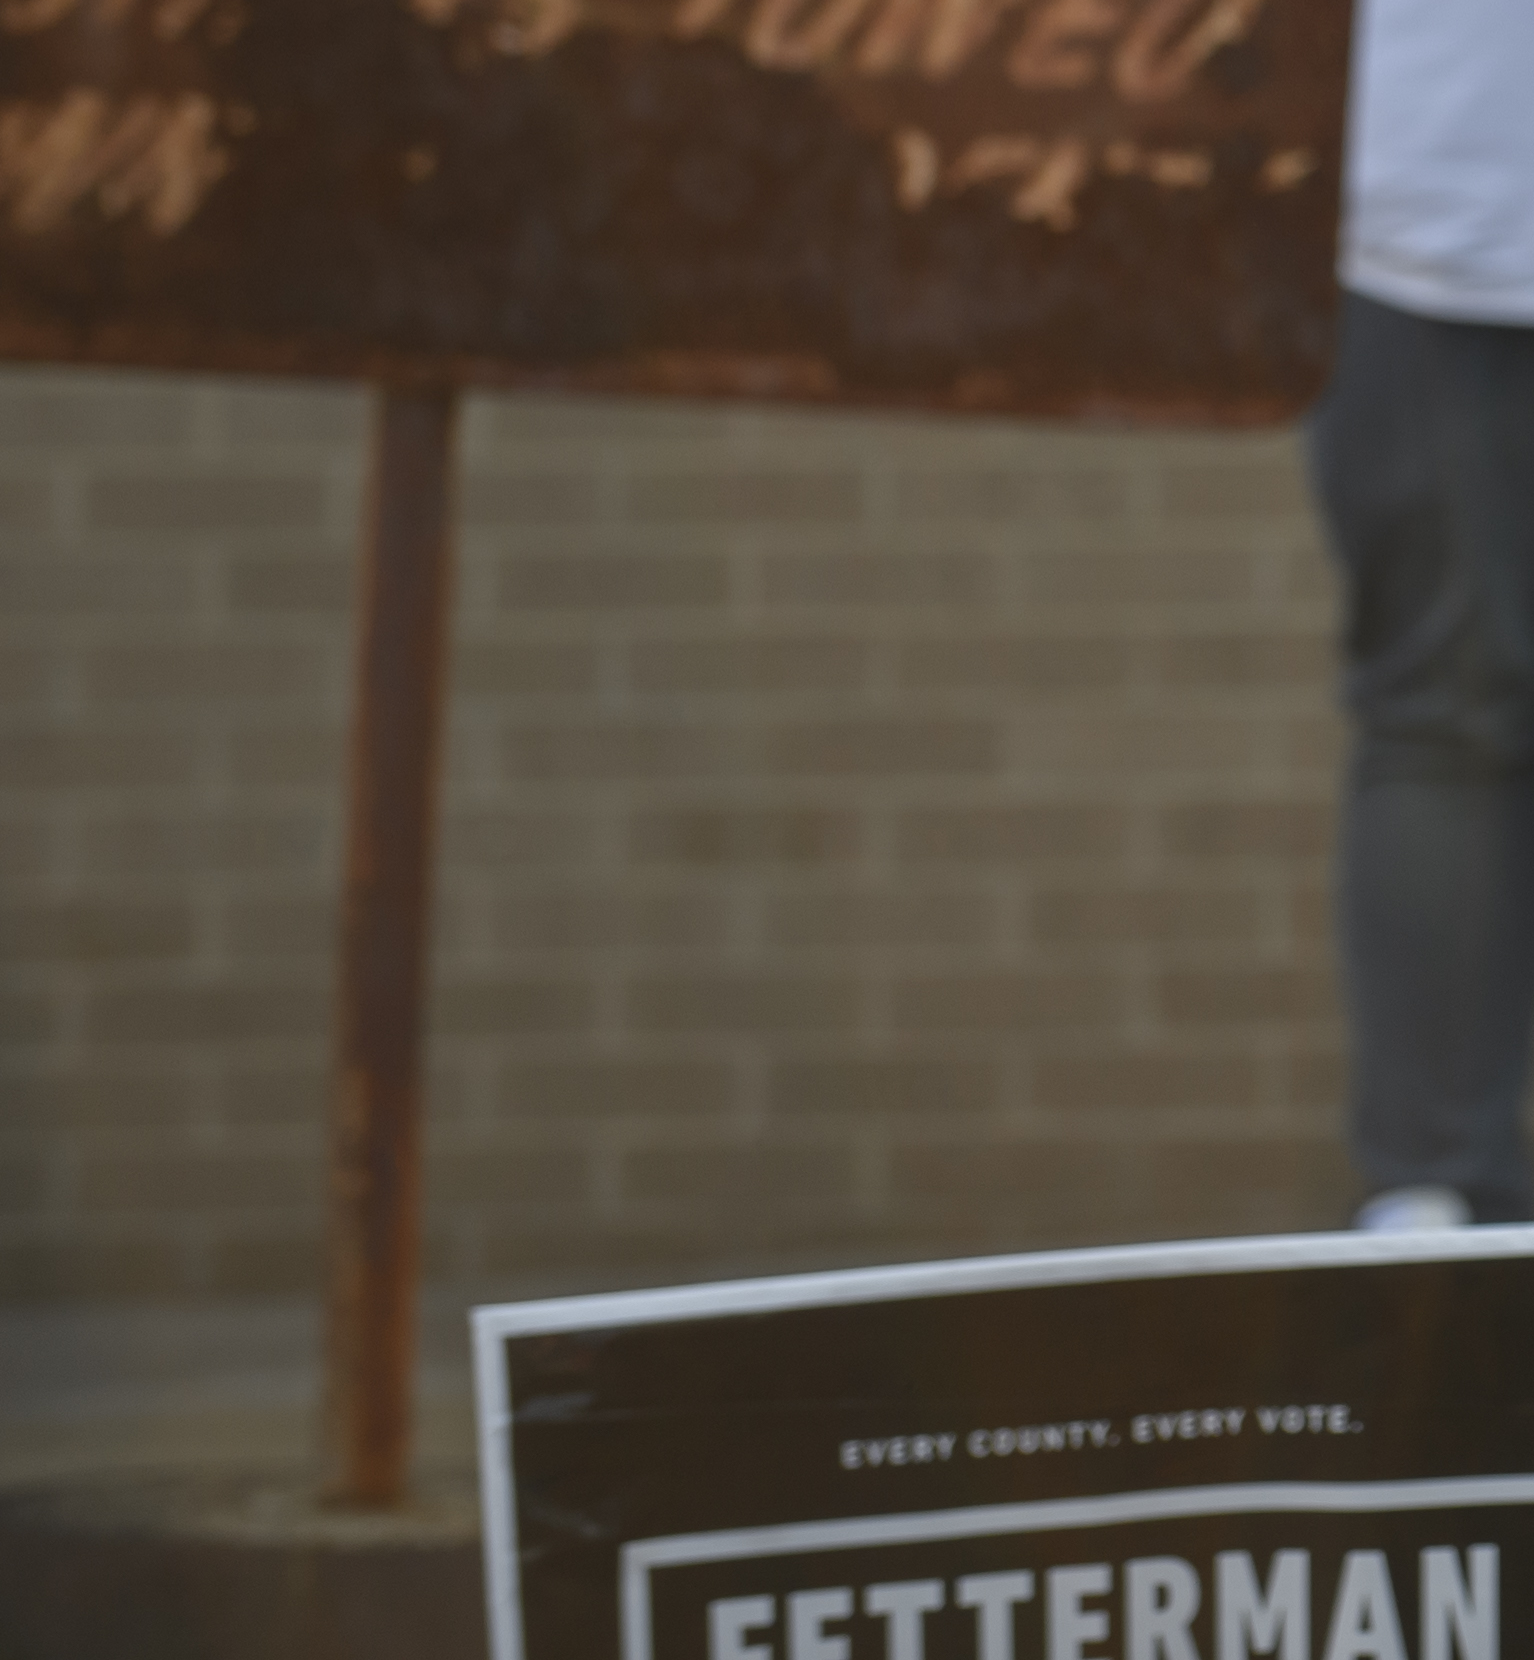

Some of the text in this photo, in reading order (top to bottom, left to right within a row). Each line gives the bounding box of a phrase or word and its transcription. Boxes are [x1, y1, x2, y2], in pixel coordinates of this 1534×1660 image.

[838, 1403, 1365, 1470] EVERY COUNTY. EVERY VOTE.
[706, 1543, 1501, 1660] FETTERMAN
